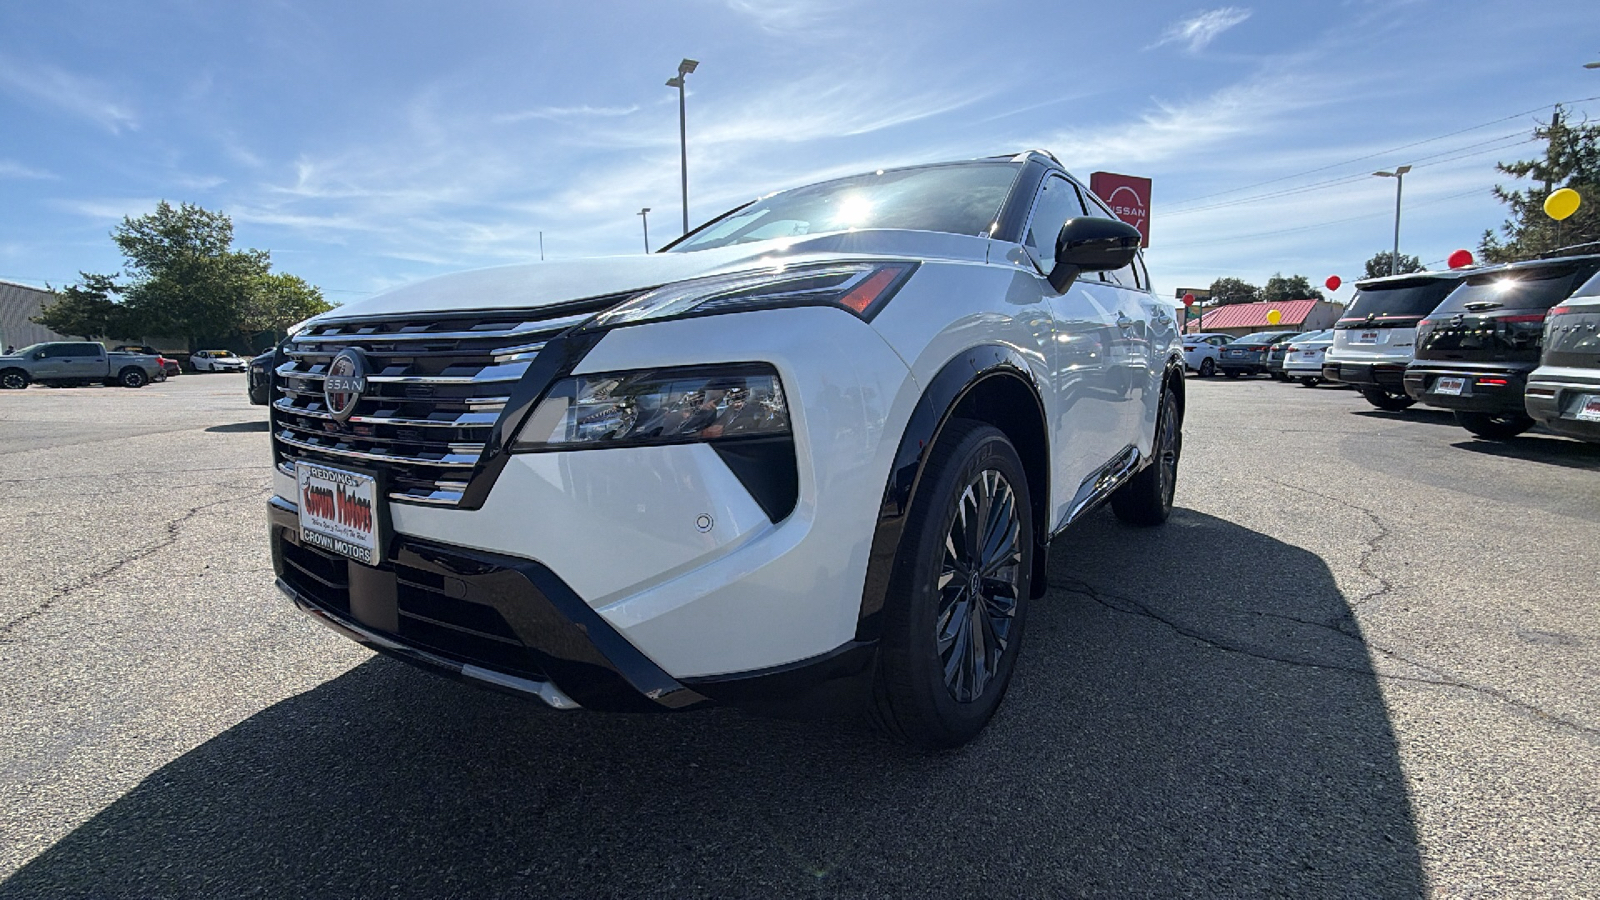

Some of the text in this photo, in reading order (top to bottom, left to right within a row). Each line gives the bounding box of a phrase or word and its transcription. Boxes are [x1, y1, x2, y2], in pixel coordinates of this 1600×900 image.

[311, 467, 352, 486] REDDING
[304, 530, 371, 562] CROWN MOTORS
